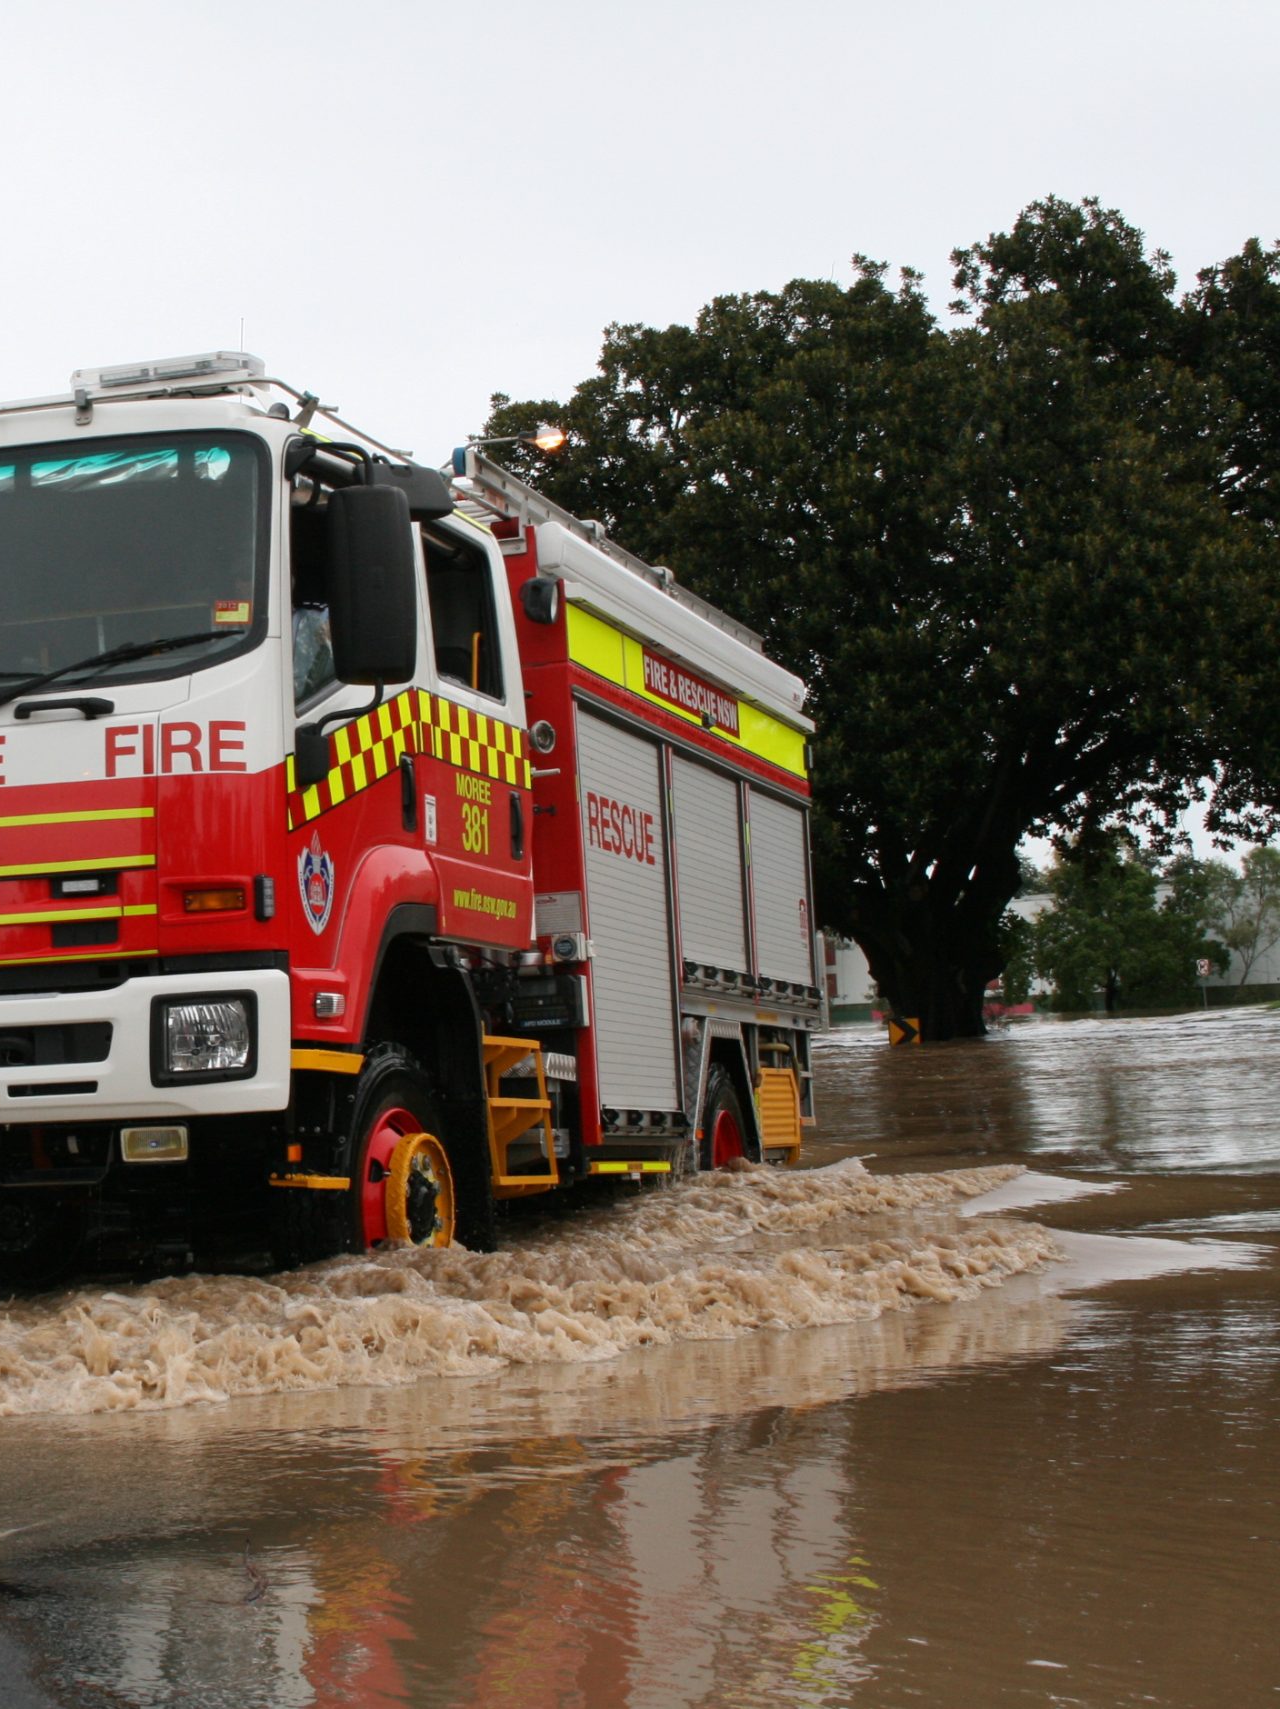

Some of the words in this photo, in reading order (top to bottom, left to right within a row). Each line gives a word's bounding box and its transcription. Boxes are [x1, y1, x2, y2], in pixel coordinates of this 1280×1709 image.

[643, 654, 669, 695] FIRE
[669, 669, 678, 699] &
[677, 674, 718, 720] RESCUE
[716, 695, 738, 731] NSW
[105, 720, 247, 778] FIRE
[456, 772, 491, 805] MOREE
[462, 802, 489, 856] 381
[586, 791, 655, 866] RESCUE
[453, 887, 517, 921] www.fire.nsw.gov.au
